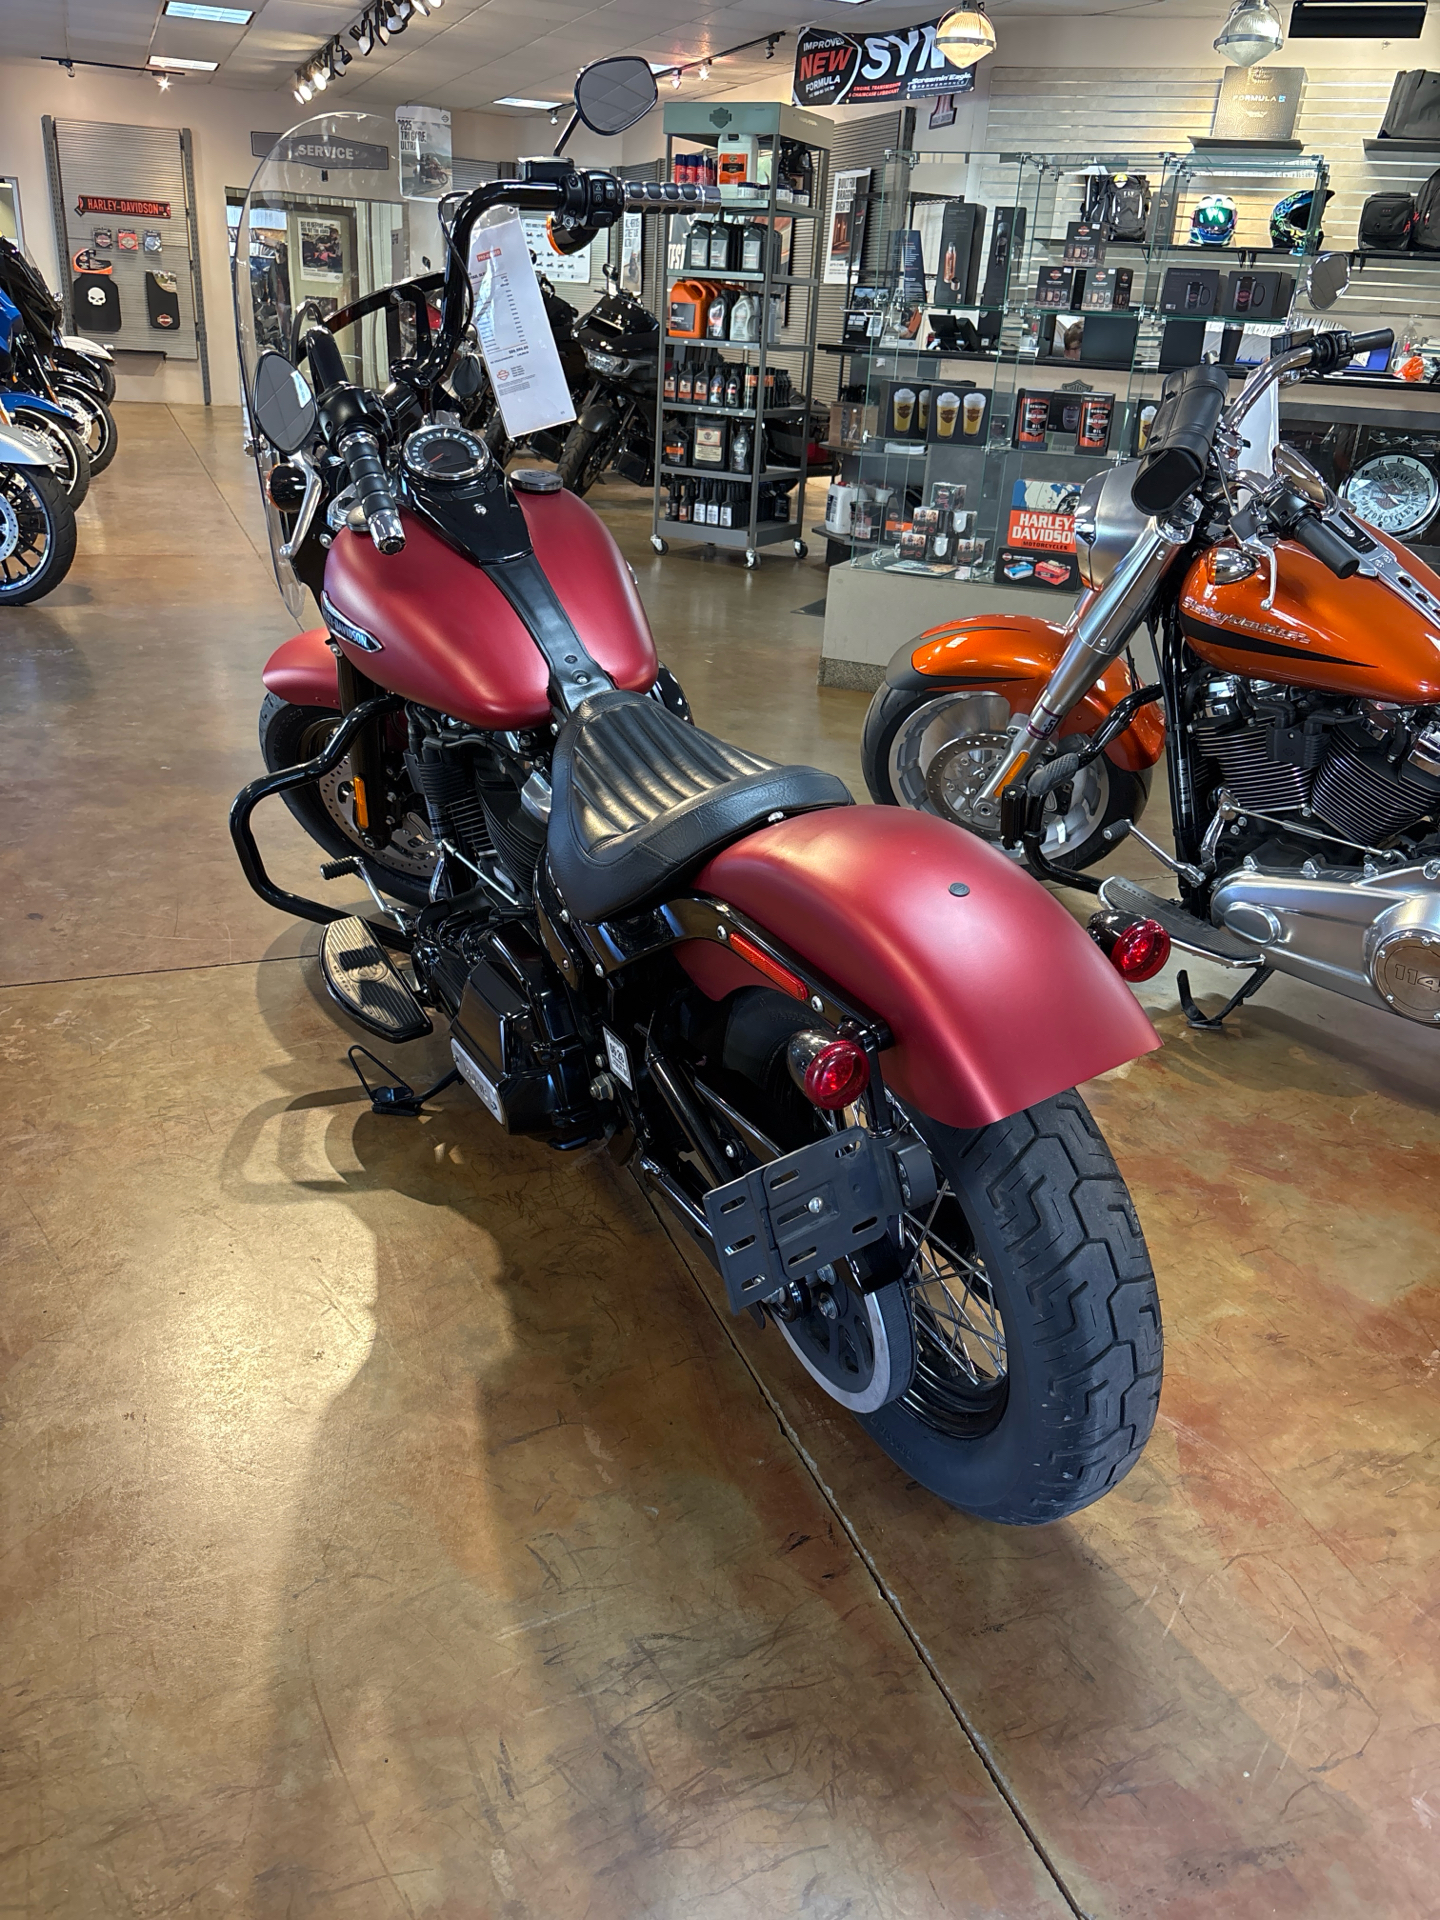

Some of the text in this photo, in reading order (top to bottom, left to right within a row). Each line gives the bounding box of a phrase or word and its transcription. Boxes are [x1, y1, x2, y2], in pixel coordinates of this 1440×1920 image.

[803, 37, 844, 51] IMPROVED
[861, 25, 955, 80] SYN
[800, 47, 853, 81] NEW
[805, 75, 841, 92] FORMULA
[1232, 94, 1277, 102] FORMULA
[411, 131, 426, 142] GDE
[298, 144, 354, 160] SERVICE
[87, 198, 159, 214] HARLEY-DAVIDSON
[478, 249, 500, 260] PRE-OED
[1019, 513, 1074, 531] HARLEY-
[1023, 541, 1068, 550] MOTORCYCLES
[1395, 964, 1440, 993] 114
[868, 1414, 914, 1462] DUNLO
